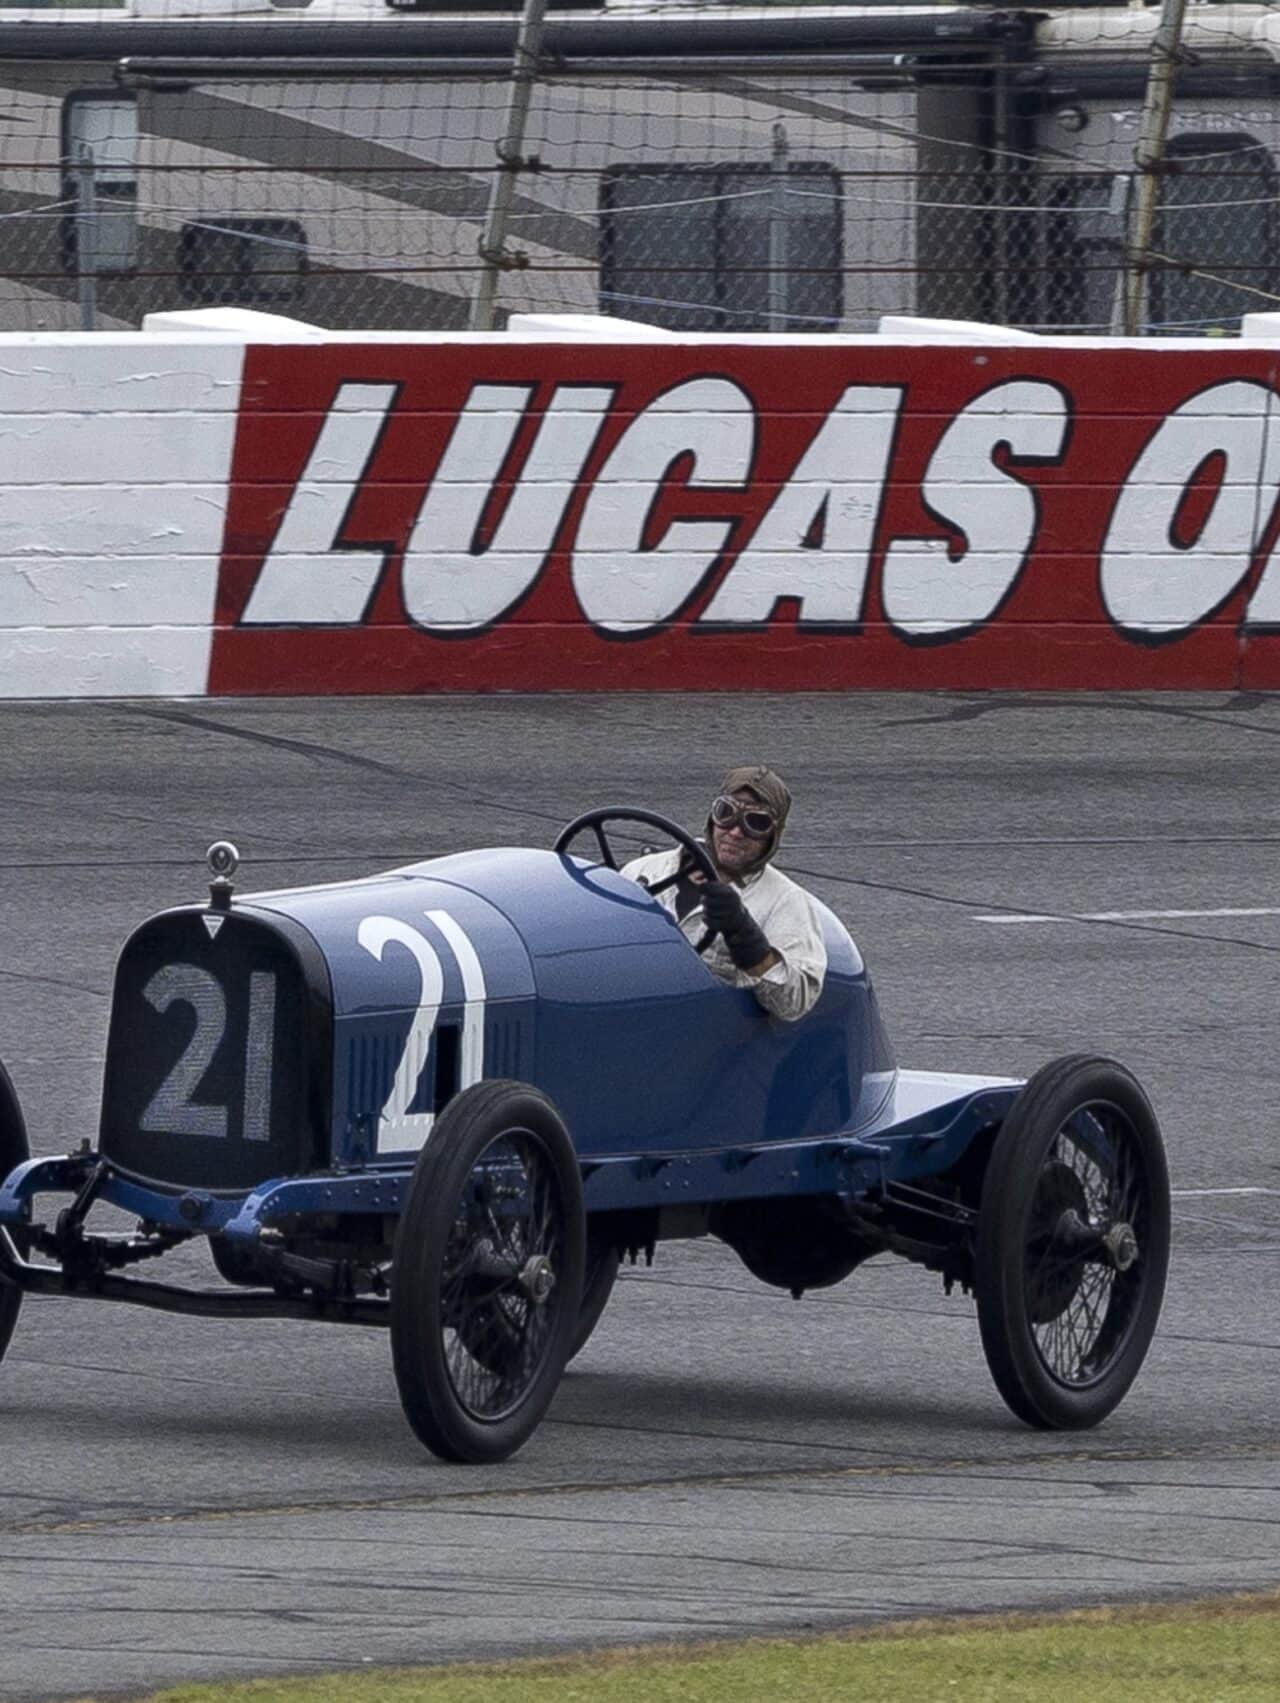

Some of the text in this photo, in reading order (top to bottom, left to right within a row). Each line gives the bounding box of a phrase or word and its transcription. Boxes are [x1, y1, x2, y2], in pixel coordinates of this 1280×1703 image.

[234, 374, 1280, 648] LUCAS O
[139, 962, 277, 1142] 21
[357, 909, 487, 1153] 21
